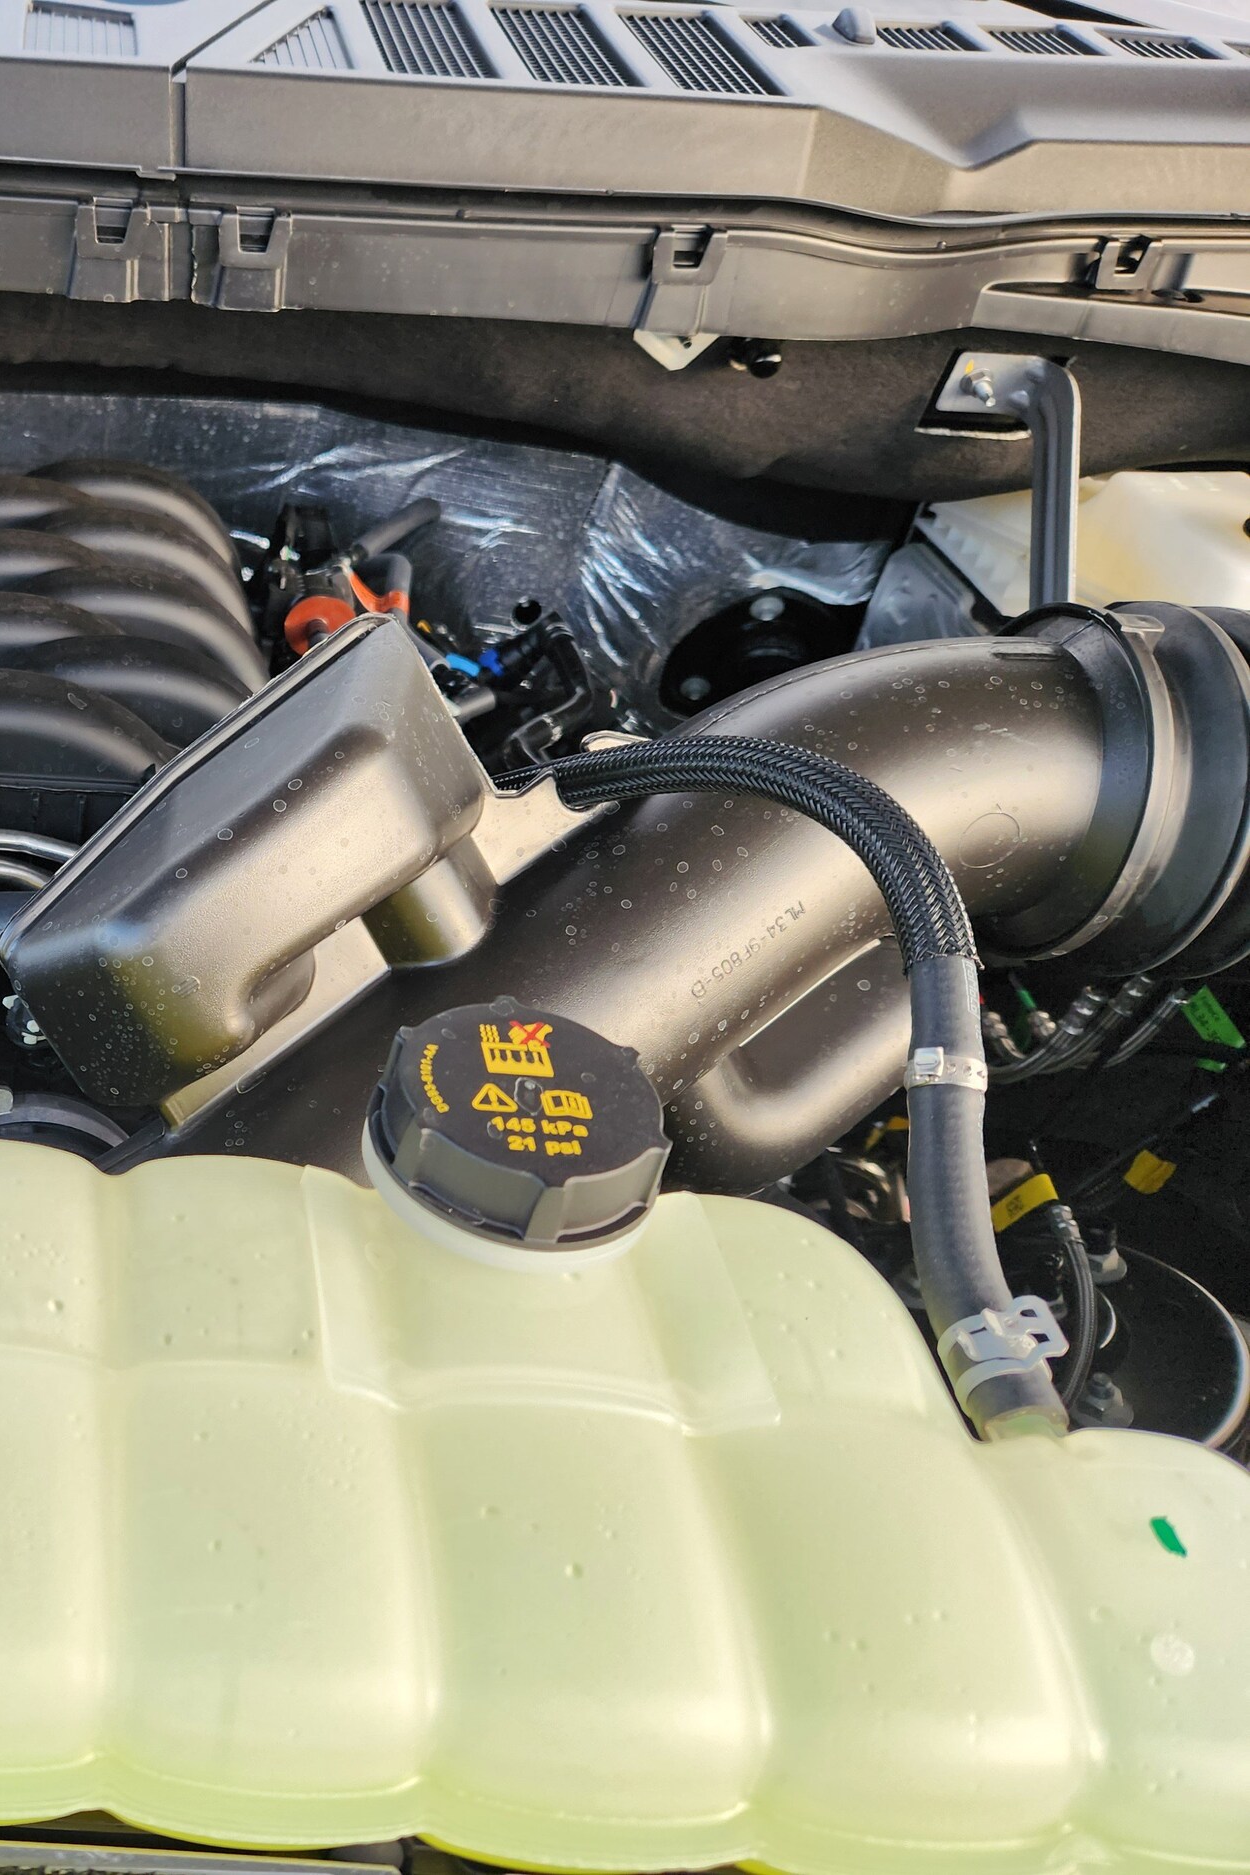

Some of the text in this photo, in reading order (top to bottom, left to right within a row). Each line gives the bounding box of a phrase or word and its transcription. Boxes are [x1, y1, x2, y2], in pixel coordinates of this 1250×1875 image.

[491, 1116, 589, 1137] 145 kPa
[507, 1135, 582, 1156] 21 psi
